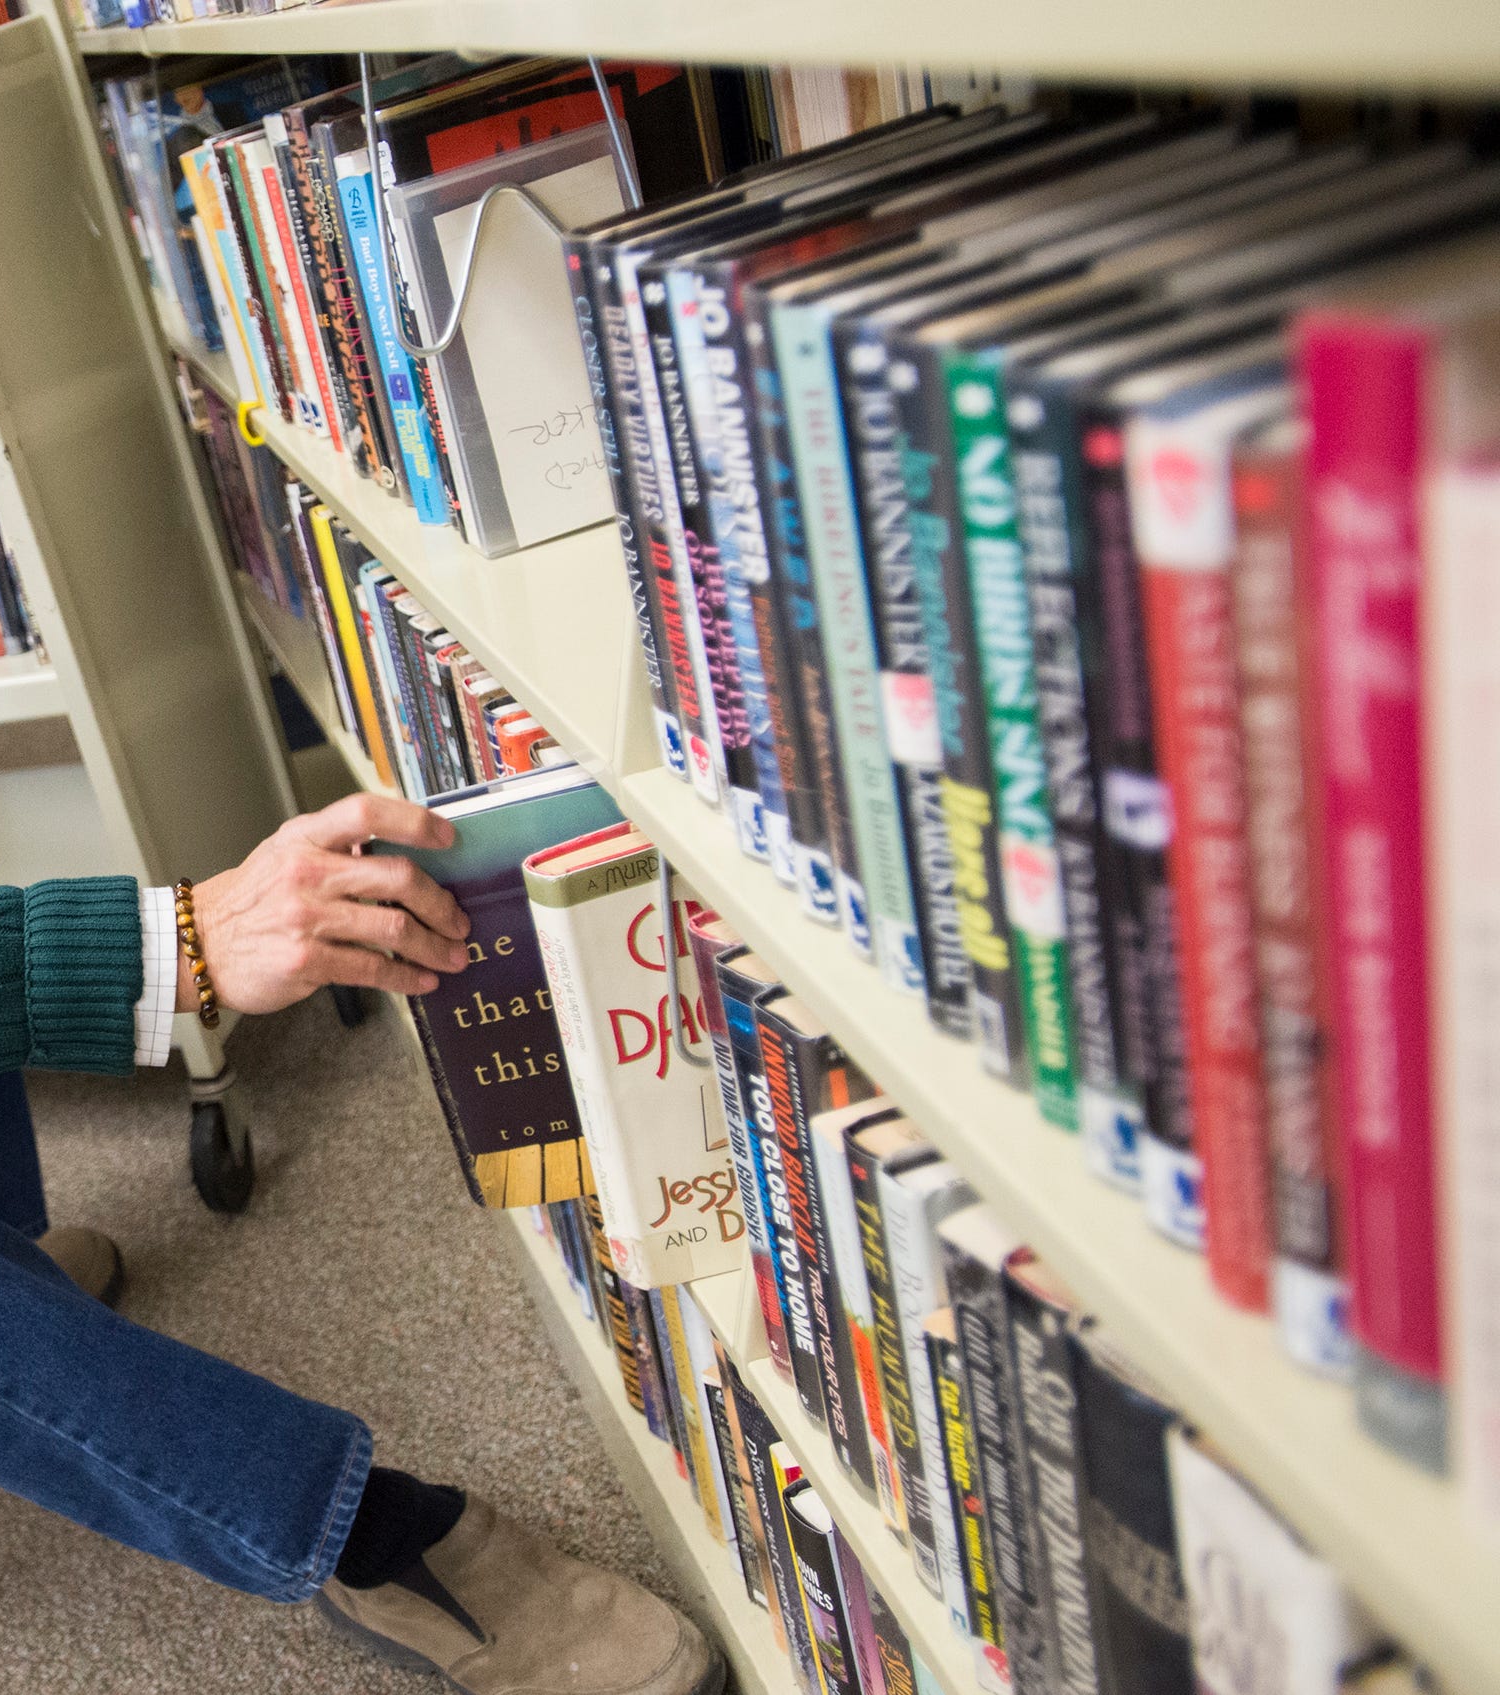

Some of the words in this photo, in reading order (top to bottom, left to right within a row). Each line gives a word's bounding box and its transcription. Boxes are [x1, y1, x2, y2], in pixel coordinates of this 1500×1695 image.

[285, 187, 313, 266] RICHARD
[309, 178, 337, 242] RICHARD
[356, 234, 375, 263] Bad
[363, 264, 384, 302] Boys
[373, 302, 393, 337] Next
[694, 279, 731, 338] JO
[382, 337, 401, 370] Exit
[573, 293, 607, 396] CLOSER
[600, 301, 642, 403] DEADLY
[655, 331, 676, 368] JO
[420, 367, 440, 409] MICHAEL
[800, 385, 832, 456] THE
[849, 380, 893, 441] JO
[595, 406, 621, 476] STILL
[622, 413, 665, 525] VIRTUES
[657, 368, 702, 509] BANNISTER
[705, 342, 772, 587] BANNISTER
[957, 433, 1011, 527] NO
[614, 508, 635, 548] JO
[645, 532, 672, 572] JO
[681, 527, 704, 576] OF
[858, 443, 929, 670] BANNISTER
[699, 542, 728, 607] THE
[622, 550, 663, 690] BANNISTER
[652, 571, 702, 721] BANNISTER
[691, 580, 737, 752] SOLITUDE
[712, 616, 755, 749] DEPTHS
[904, 760, 958, 892] LAZARUS
[586, 880, 598, 892] A
[926, 890, 972, 990] HOTEL
[453, 988, 554, 1030] that
[549, 983, 575, 1048] DAGGERS
[474, 1047, 562, 1087] this
[711, 1038, 734, 1073] NO
[754, 1019, 803, 1150] LINWOOD
[717, 1070, 743, 1121] TIME
[745, 1069, 777, 1135] TOO
[726, 1118, 749, 1161] FOR
[783, 1061, 813, 1150] INTERNATIONAL
[798, 1152, 823, 1221] BESTSELLING
[732, 1157, 767, 1248] GOODBYE
[755, 1134, 797, 1233] CLOSE
[776, 1139, 822, 1265] BARCLAY
[665, 1226, 708, 1251] AND
[776, 1233, 802, 1275] TO
[849, 1193, 896, 1287] THE
[889, 1204, 917, 1266] THE
[781, 1271, 819, 1360] HOME
[804, 1262, 832, 1338] TRUST
[897, 1262, 934, 1358] BOOK
[816, 1328, 840, 1388] YOUR
[860, 1283, 928, 1452] HUNTED
[825, 1381, 849, 1443] EYES
[960, 1305, 991, 1368] CLIVE
[991, 1523, 1025, 1597] BLOOD
[1028, 1442, 1082, 1533] THE
